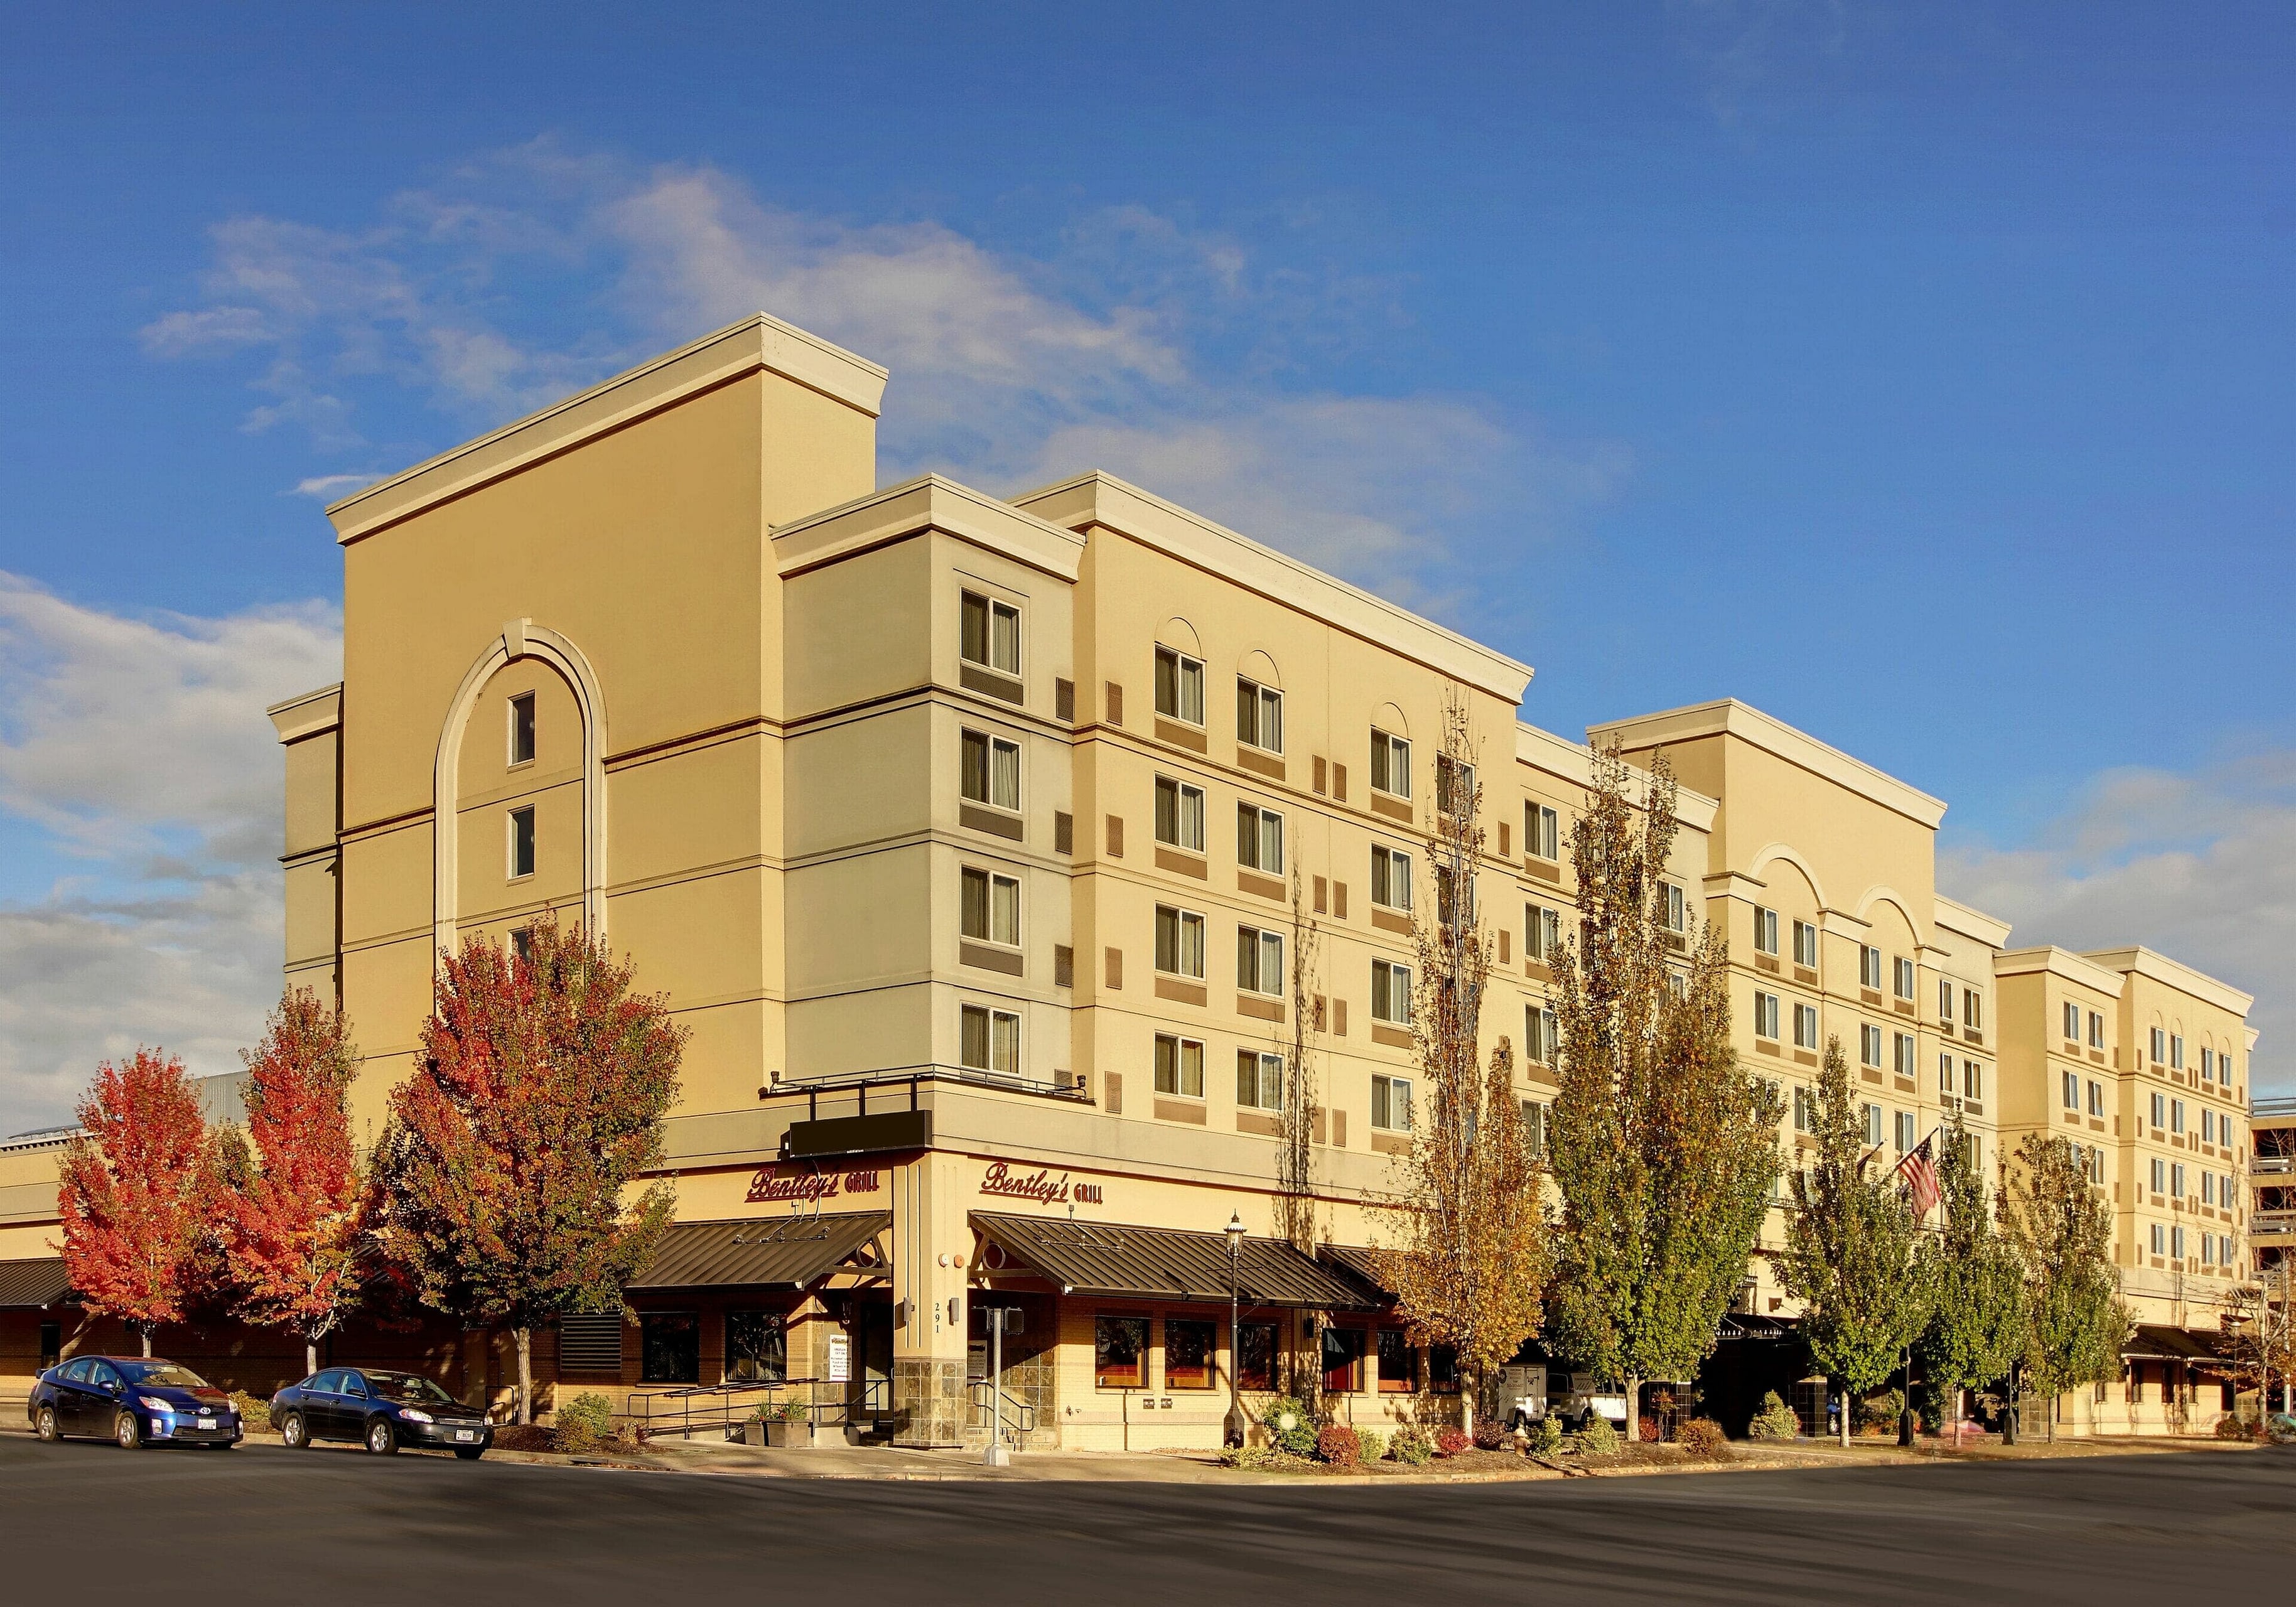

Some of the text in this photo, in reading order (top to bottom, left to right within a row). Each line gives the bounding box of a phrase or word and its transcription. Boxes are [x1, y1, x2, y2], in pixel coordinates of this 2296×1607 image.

[746, 1168, 880, 1203] Bentley's GRILL
[981, 1162, 1103, 1205] Bentley's GRILL
